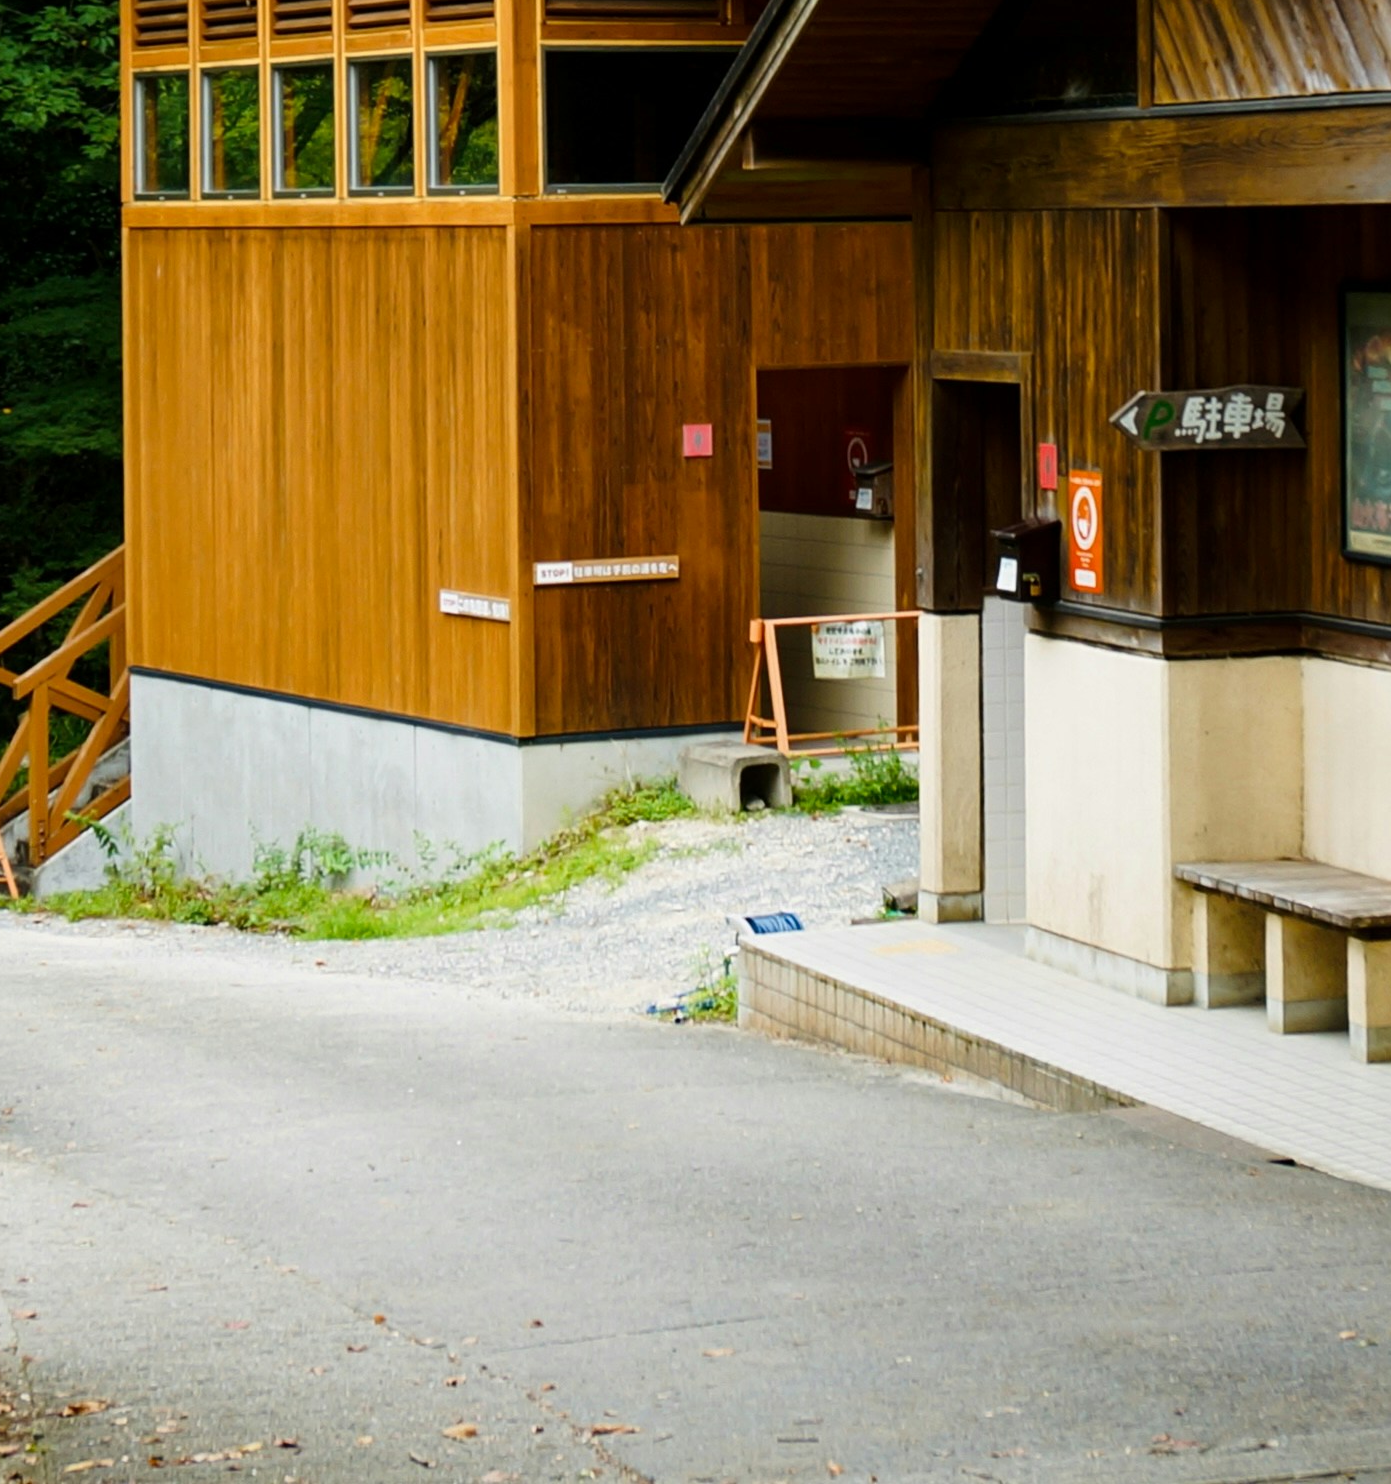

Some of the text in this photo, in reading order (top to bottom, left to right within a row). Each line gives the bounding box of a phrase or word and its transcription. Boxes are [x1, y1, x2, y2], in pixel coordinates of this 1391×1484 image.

[1142, 392, 1286, 444] P 駐車場
